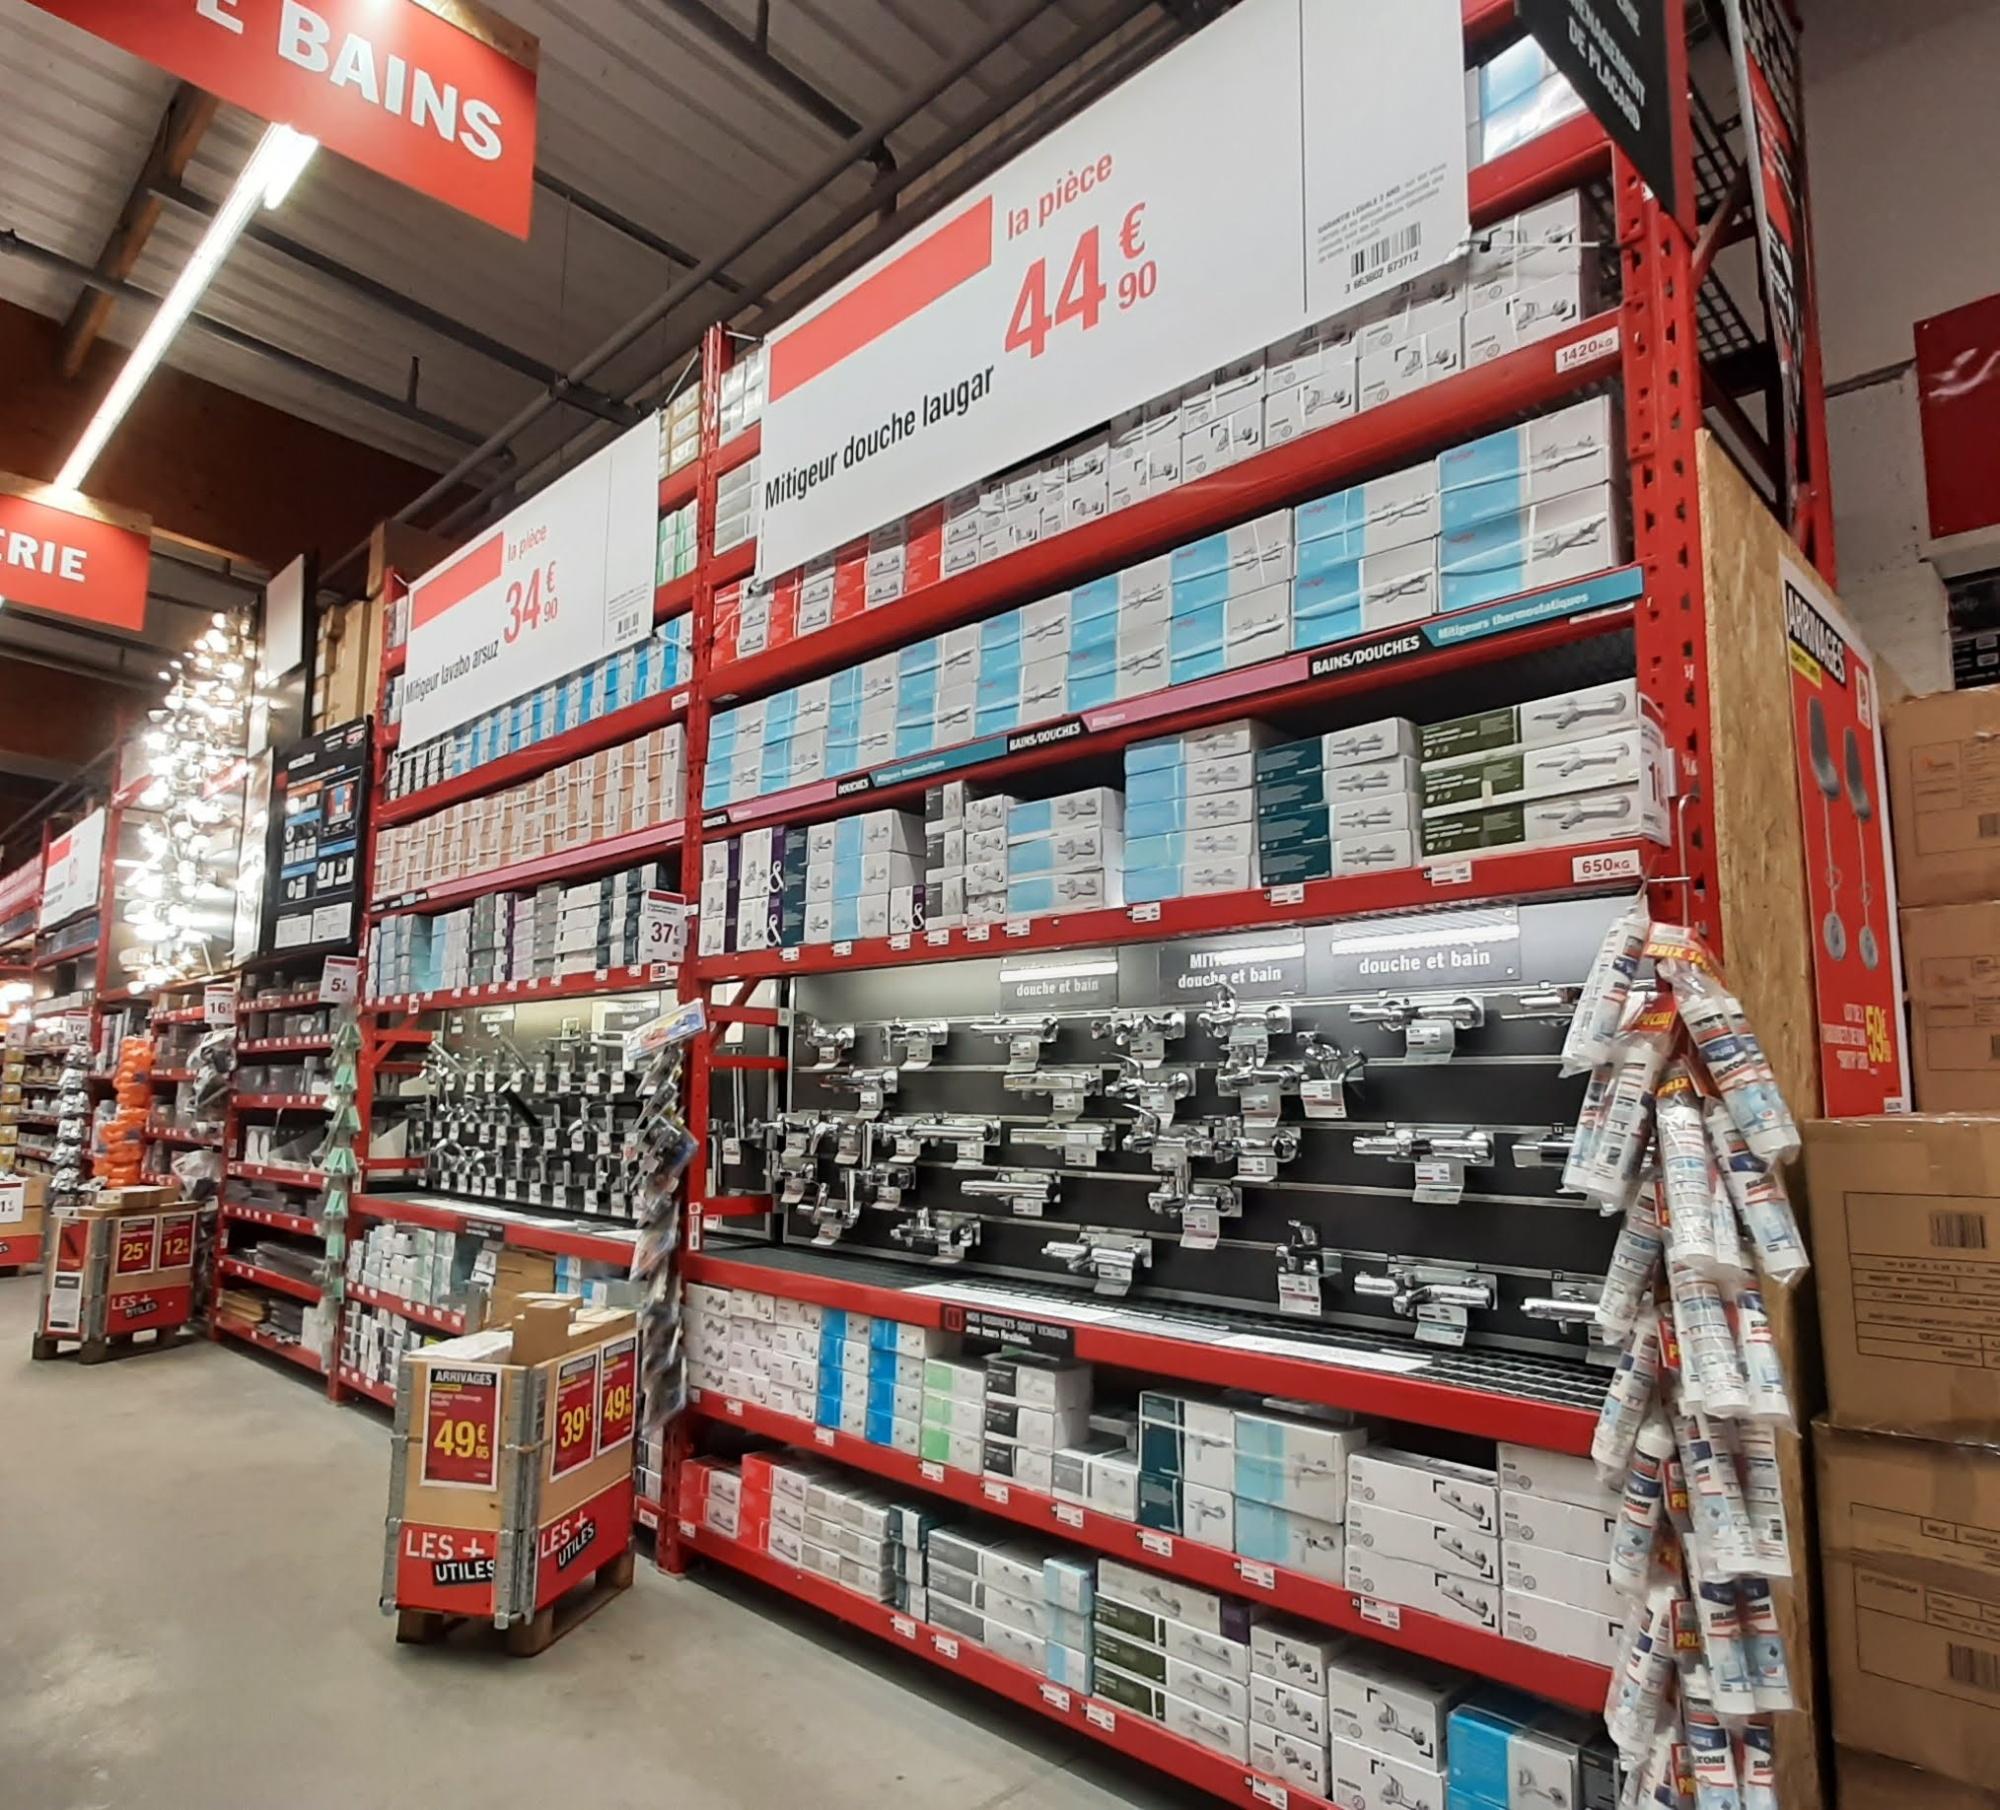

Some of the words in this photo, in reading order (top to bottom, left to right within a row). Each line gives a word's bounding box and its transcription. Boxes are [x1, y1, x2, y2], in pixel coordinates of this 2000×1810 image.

[277, 0, 502, 160] BAINS
[1008, 208, 1029, 241] la
[1039, 153, 1112, 229] pièce
[1004, 224, 1107, 360] 44
[1118, 260, 1157, 310] 90
[765, 451, 838, 511] Mitigeur
[843, 410, 915, 470] douche
[923, 365, 995, 427] laugar
[0, 527, 88, 583] RIE
[507, 542, 518, 562] la
[518, 524, 548, 560] pièce
[503, 567, 542, 645] 34
[543, 597, 558, 623] 90
[1311, 634, 1421, 676] BAINS/DOUCHES
[405, 672, 439, 704] Mitigeur
[441, 653, 471, 685] lavabo
[1009, 721, 1082, 752] BAINS/DOUCHES
[651, 921, 673, 944] 37
[1645, 943, 1685, 960] PRIX
[1177, 971, 1228, 989] douche
[1230, 971, 1245, 984] et
[1250, 965, 1282, 982] bain
[1359, 953, 1421, 975] douche
[1426, 952, 1445, 969] et
[1451, 948, 1491, 968] bain
[1016, 980, 1056, 997] douche
[1058, 980, 1071, 994] et
[1073, 978, 1099, 993] bain
[122, 1243, 143, 1261] 25
[164, 1238, 182, 1256] 12
[435, 1370, 493, 1386] ARRIVAGES
[604, 1385, 625, 1422] 49
[433, 1419, 476, 1458] 49
[560, 1406, 585, 1448] 39
[405, 1529, 454, 1560] LES
[540, 1519, 571, 1558] LES
[557, 1522, 594, 1567] UTILES
[435, 1559, 495, 1582] UTILES
